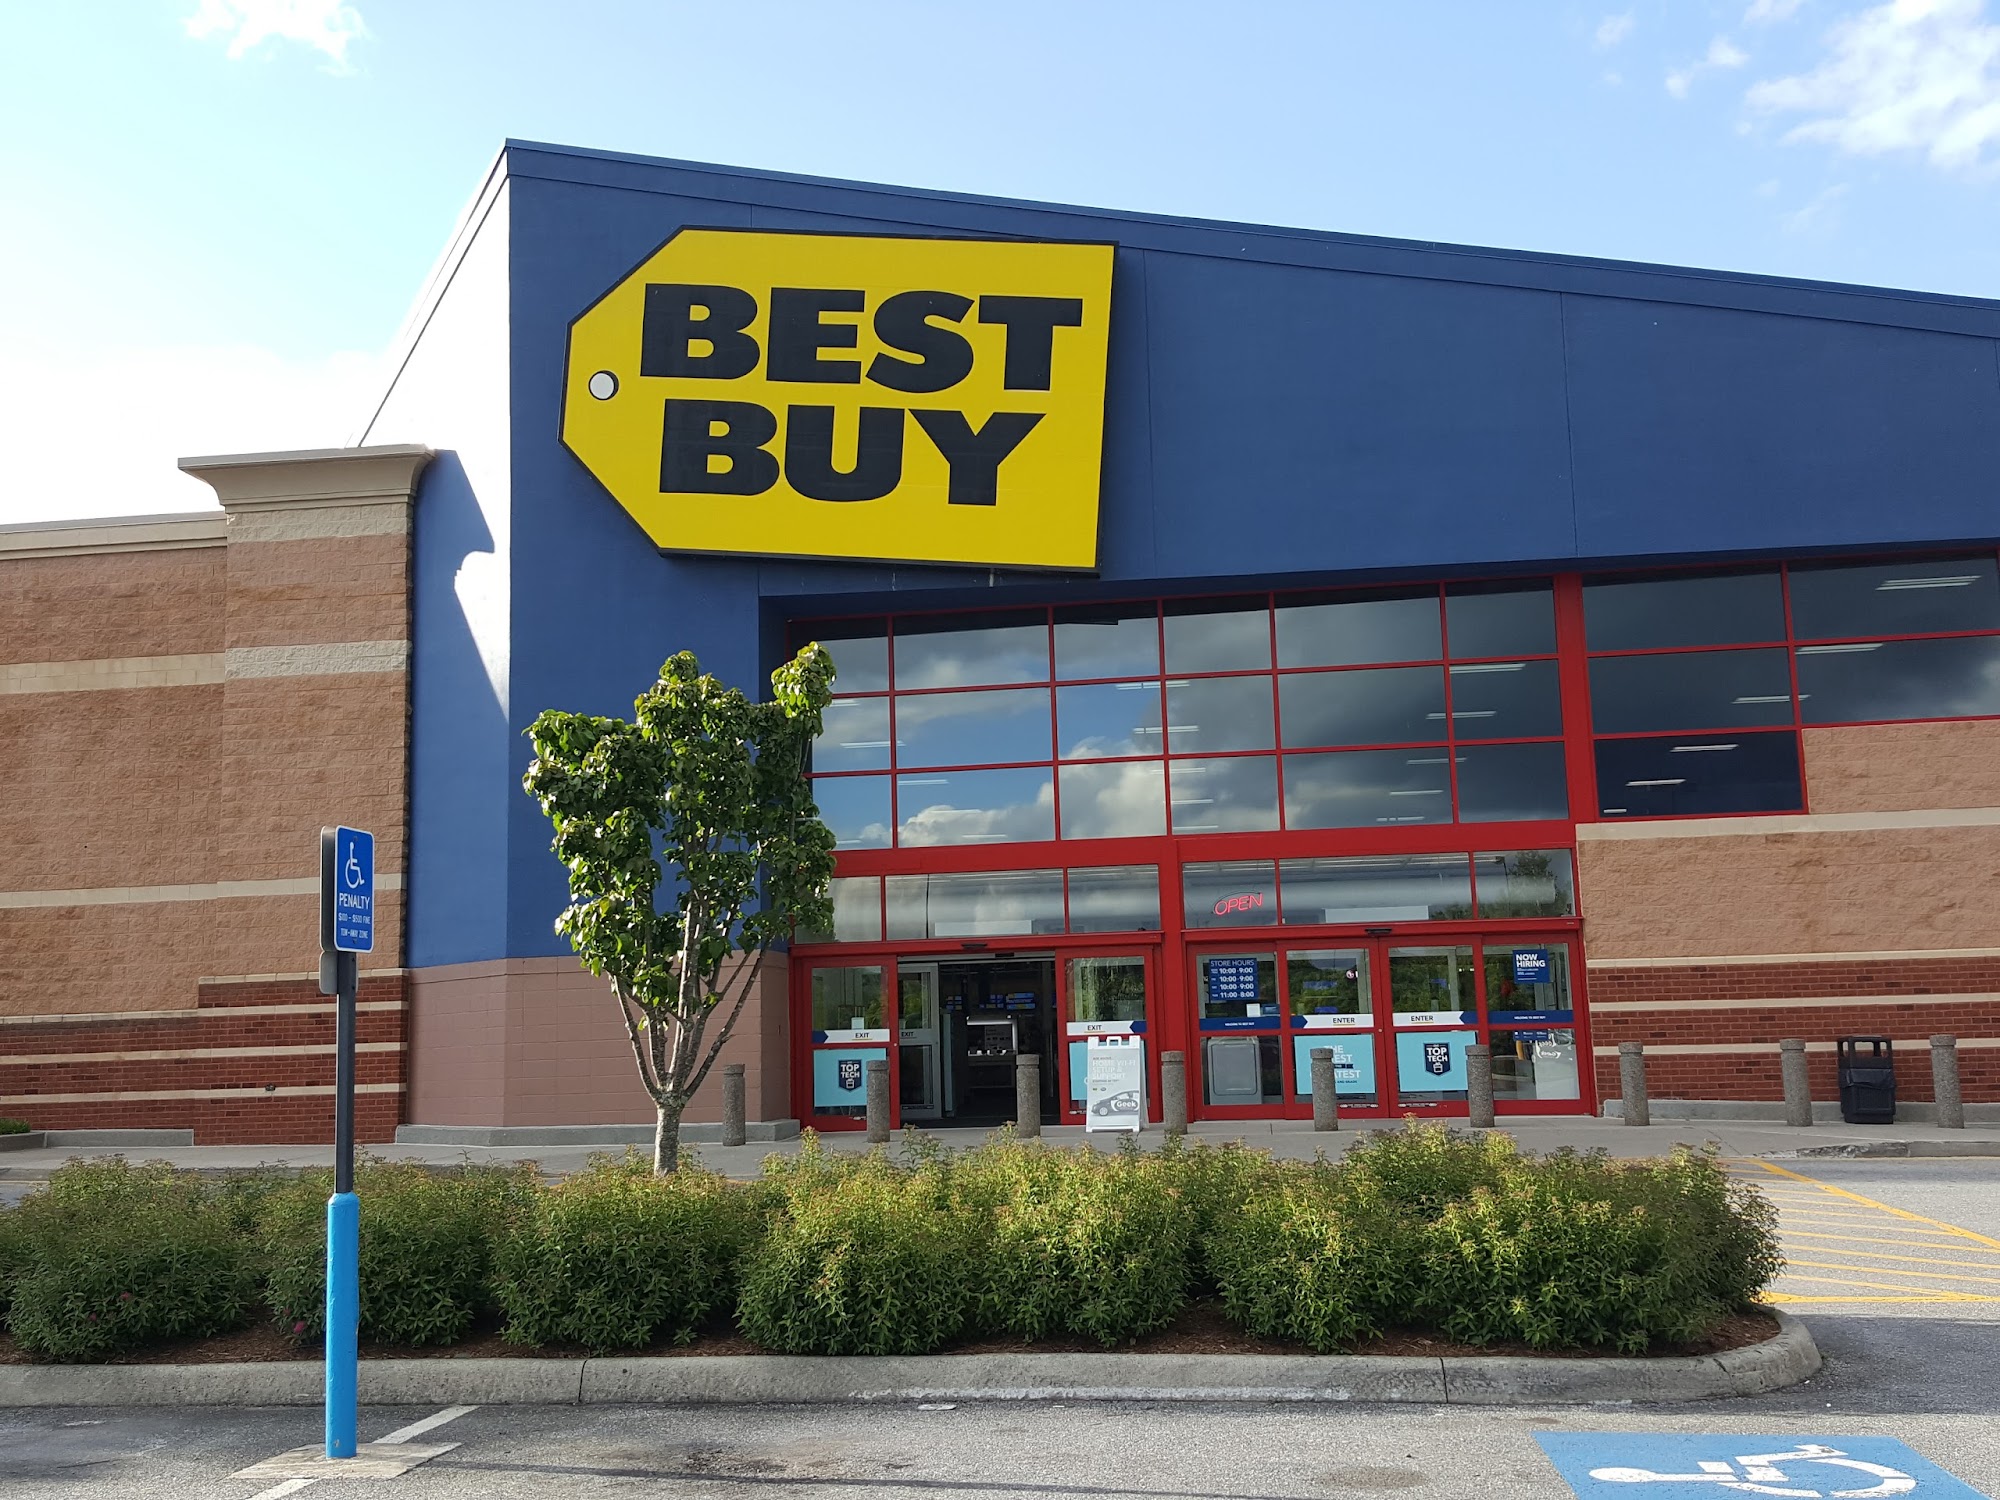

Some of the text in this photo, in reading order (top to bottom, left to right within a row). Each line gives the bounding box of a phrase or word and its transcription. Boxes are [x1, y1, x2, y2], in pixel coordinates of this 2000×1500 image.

[640, 282, 1083, 393] BEST
[659, 398, 1047, 506] BUY
[339, 893, 370, 909] PENALTY
[1214, 892, 1263, 915] OPEN
[1427, 1047, 1447, 1055] TOP
[840, 1064, 860, 1072] TOP
[1116, 1100, 1137, 1108] Geek
